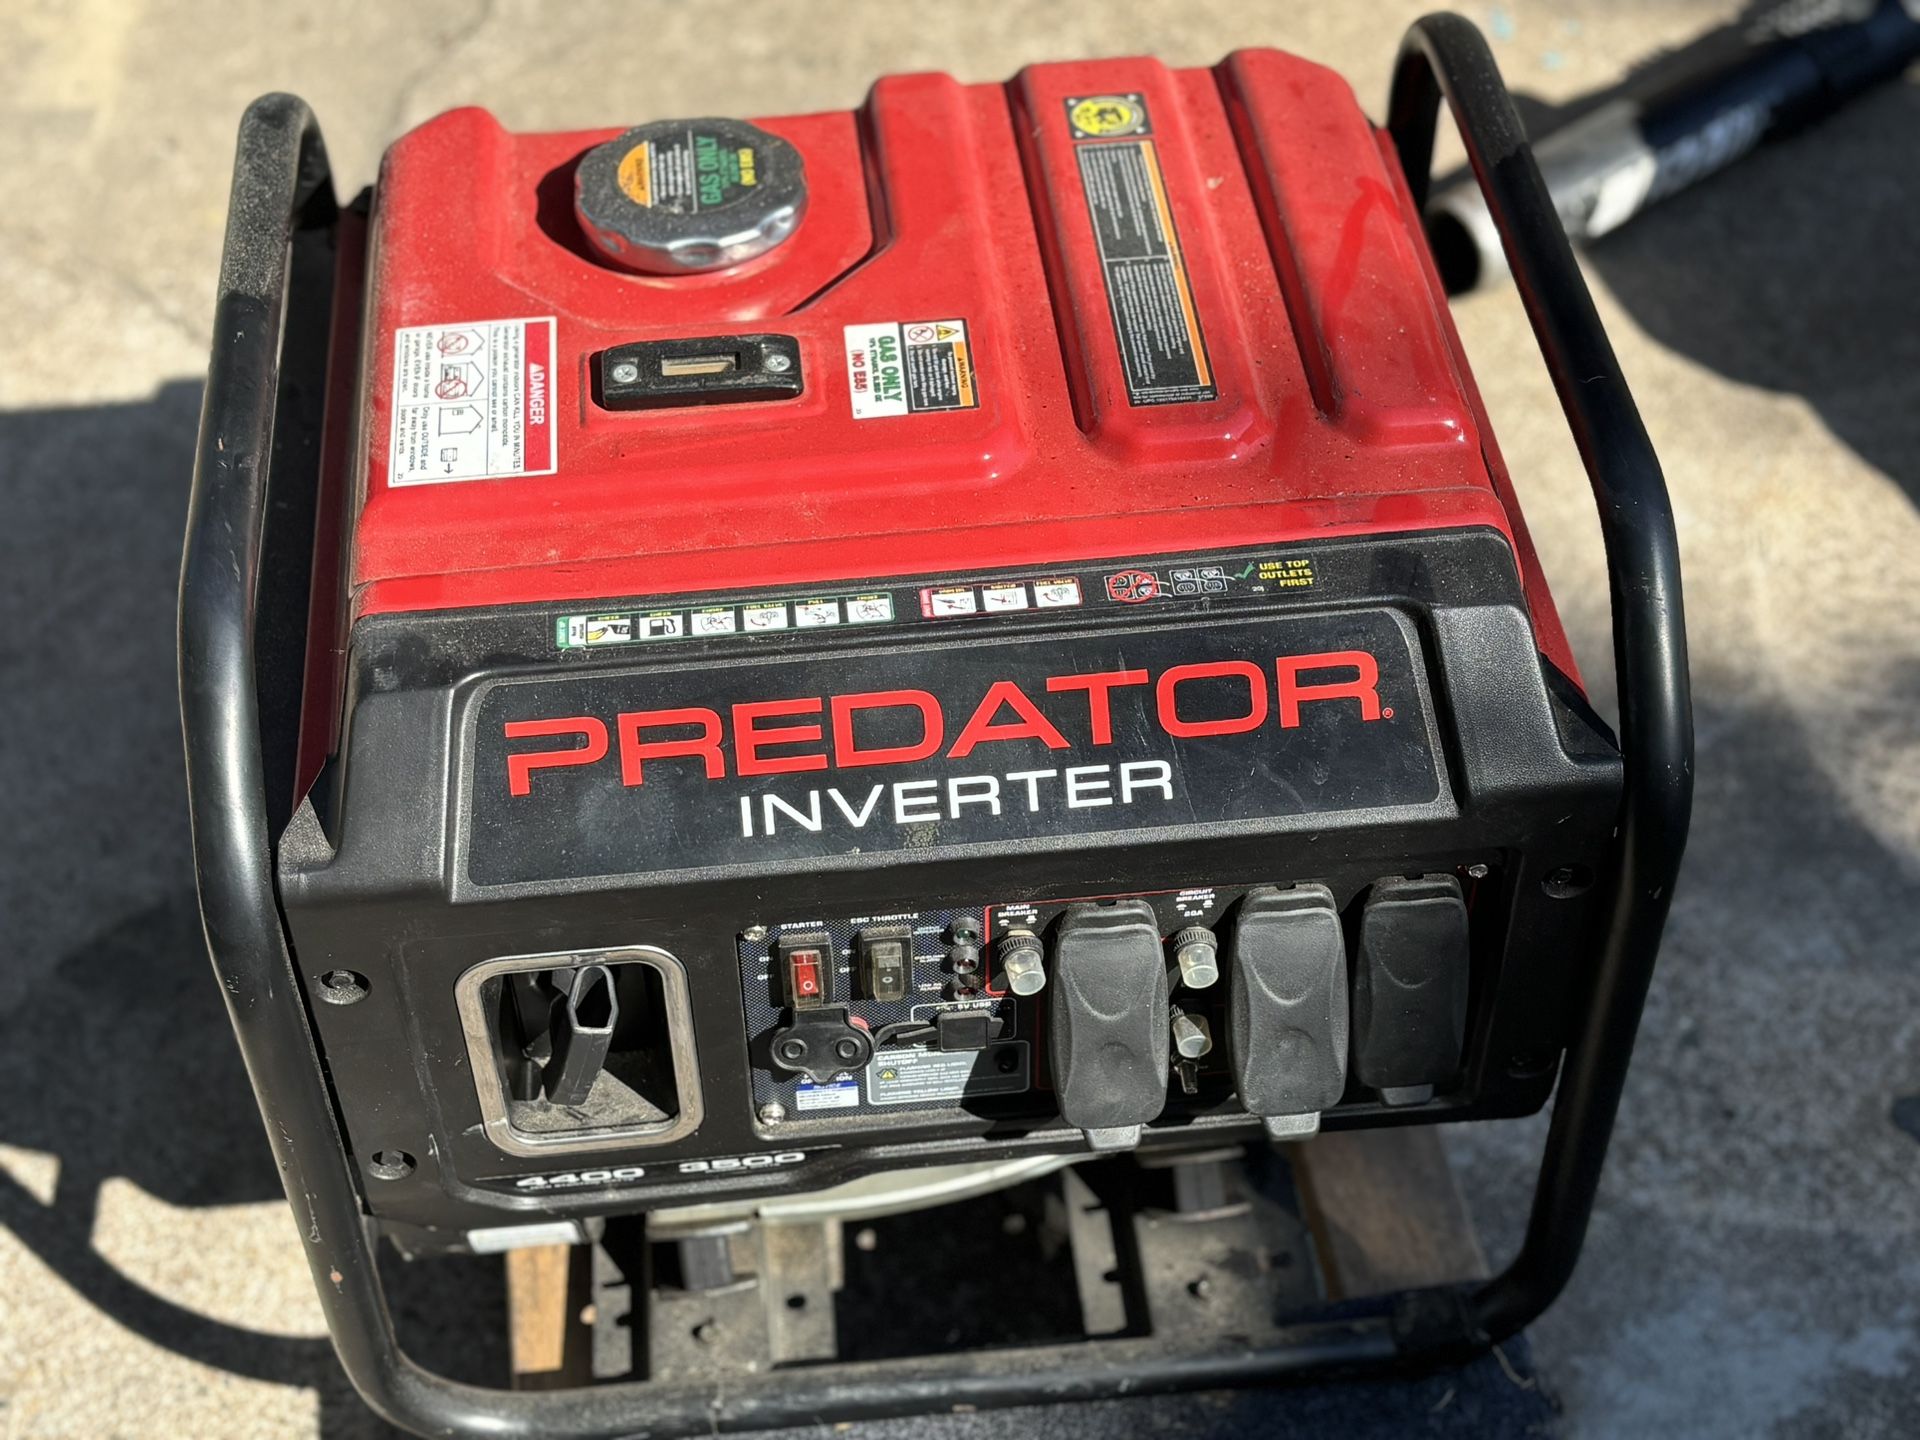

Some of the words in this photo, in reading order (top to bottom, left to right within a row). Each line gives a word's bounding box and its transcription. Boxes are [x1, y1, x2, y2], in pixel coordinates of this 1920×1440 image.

[878, 336, 897, 362] GAS
[882, 367, 902, 402] ONLY
[529, 373, 545, 425] DANGER
[1259, 562, 1283, 570] USE
[1285, 560, 1309, 568] TOP
[1259, 568, 1313, 580] OUTLETS
[1280, 577, 1314, 587] FIRST
[505, 650, 1381, 796] PREDATOR
[739, 759, 1174, 838] INVERTER
[1176, 893, 1216, 902] BREAKER
[1179, 888, 1213, 897] CIRCUIT
[872, 912, 919, 922] THROTTLE
[998, 909, 1038, 917] BREAKER
[780, 921, 824, 930] STARTER
[679, 1152, 805, 1173] 3500
[516, 1168, 645, 1187] 4400
